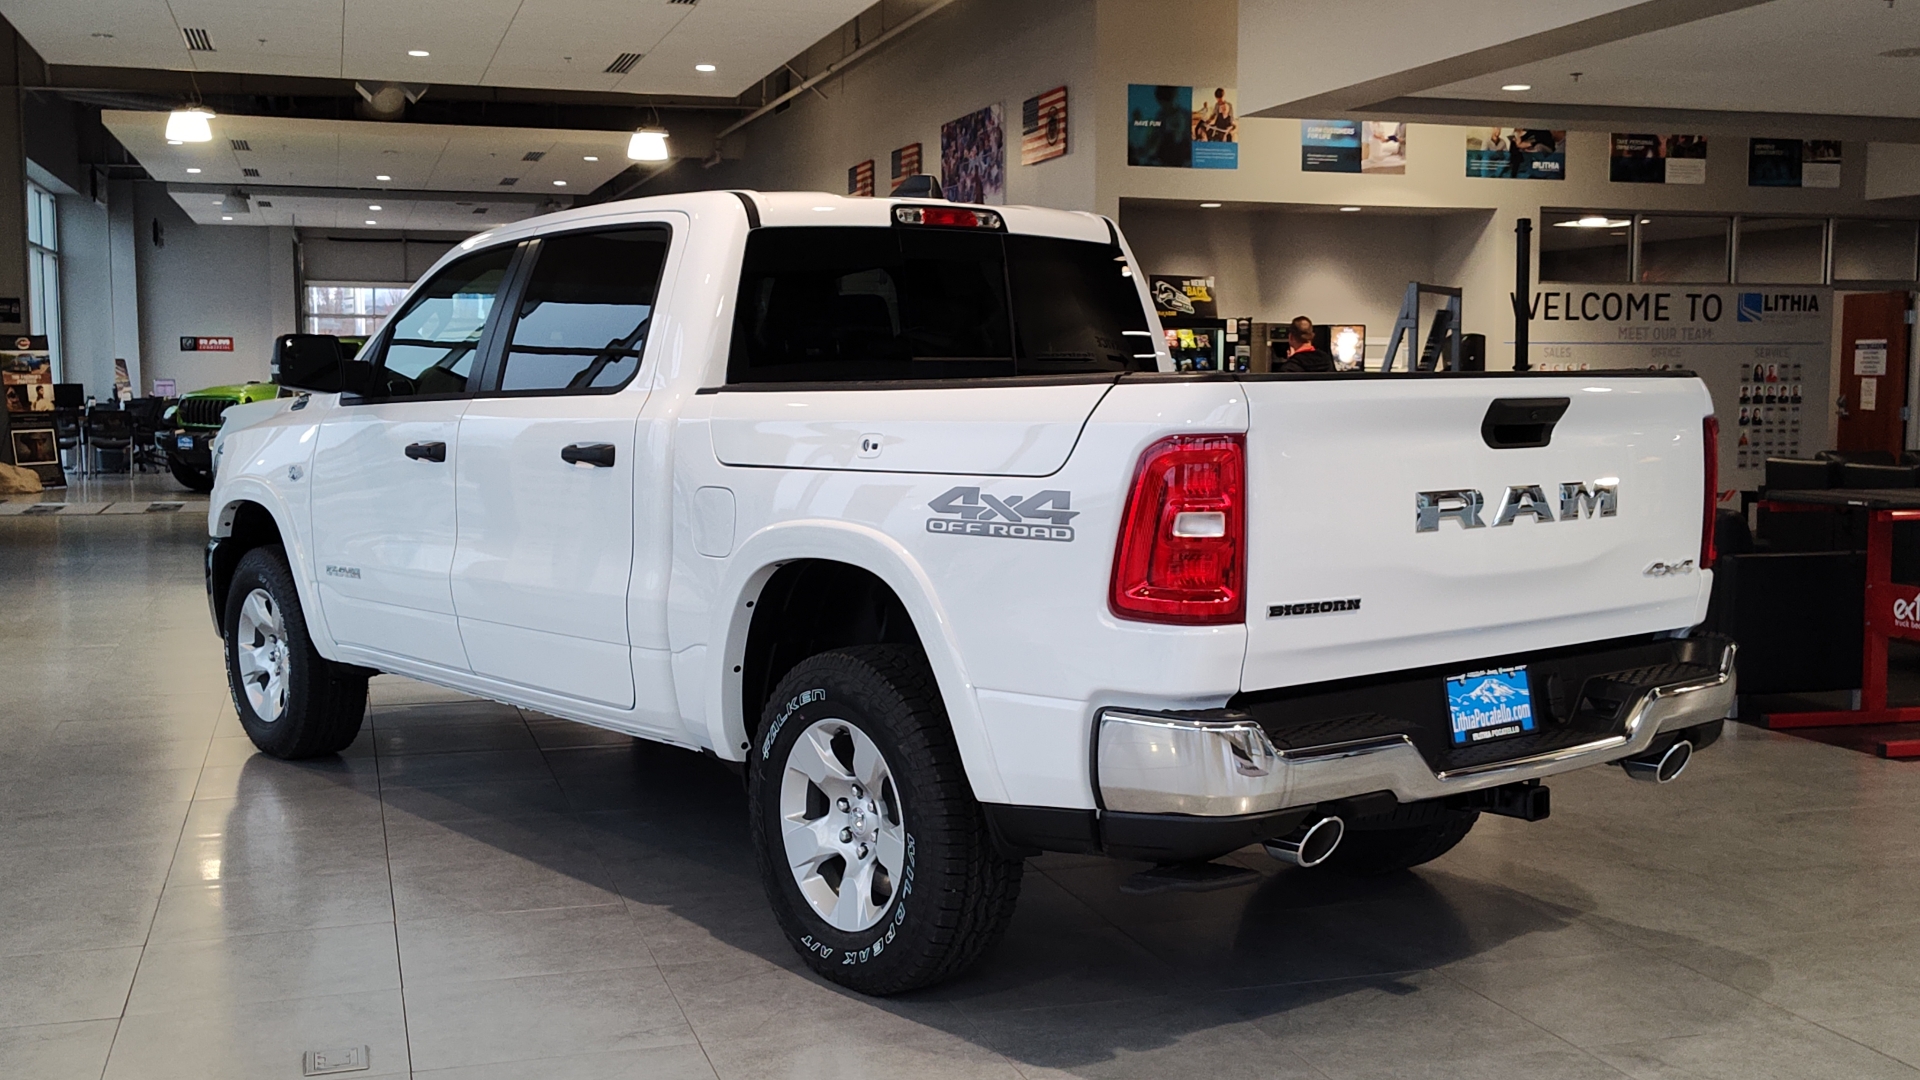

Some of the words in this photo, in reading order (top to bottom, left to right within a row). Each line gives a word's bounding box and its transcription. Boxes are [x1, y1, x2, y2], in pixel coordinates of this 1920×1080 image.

[1186, 286, 1208, 296] BACK
[1509, 292, 1671, 322] WELCOME
[1686, 293, 1723, 322] TO
[1764, 294, 1819, 312] LITHIA
[1617, 326, 1650, 340] MEET
[1652, 327, 1677, 340] OUR
[1543, 347, 1572, 358] SALES
[1755, 347, 1790, 358] SERVICE
[1415, 478, 1620, 533] RAM
[929, 521, 983, 533] OFF
[989, 524, 1072, 540] ROAD
[1269, 598, 1362, 617] BIGHORN
[761, 688, 826, 762] FALKEN
[1451, 703, 1531, 733] LithiaPocatello.com
[801, 935, 834, 959] A/T
